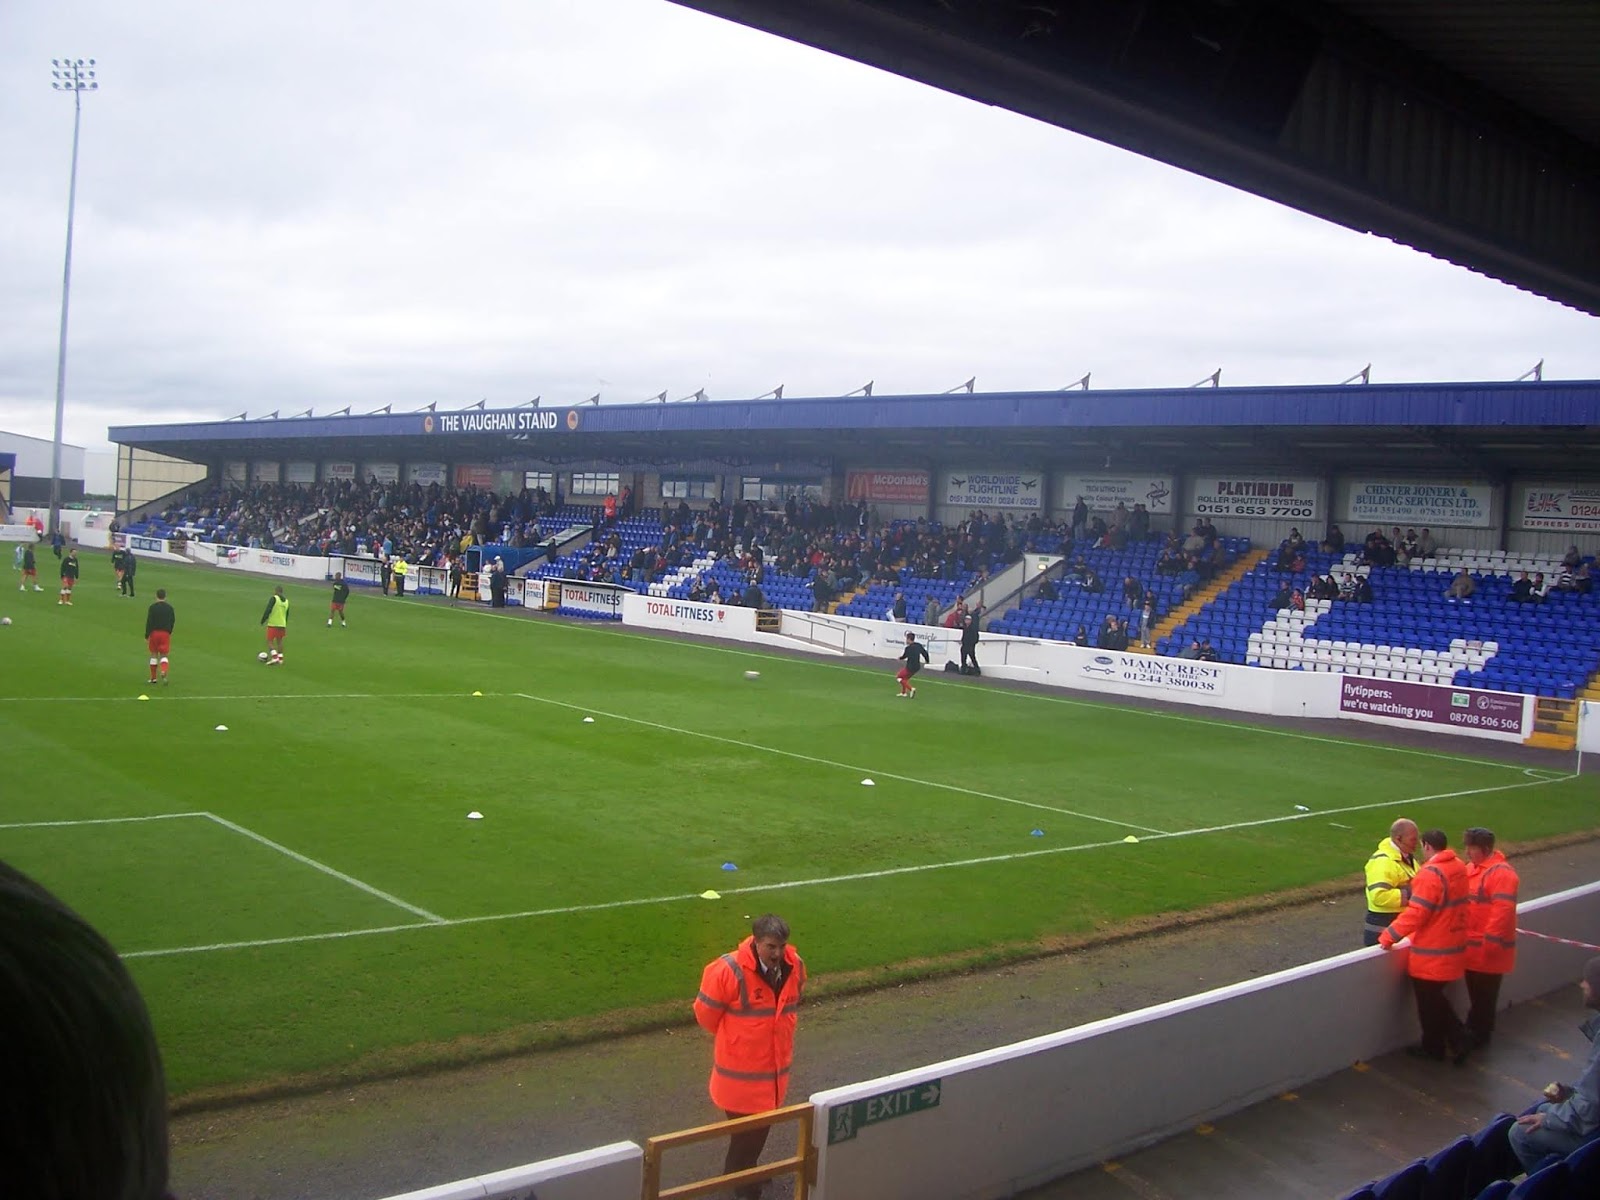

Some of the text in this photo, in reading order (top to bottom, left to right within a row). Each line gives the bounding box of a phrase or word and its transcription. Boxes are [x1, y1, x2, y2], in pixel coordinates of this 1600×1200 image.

[440, 411, 558, 431] THE VAUGHAN STAND
[873, 474, 928, 486] McDonald's
[967, 475, 1021, 485] WORLDWIDE
[968, 484, 1019, 495] FLIGHTLINE
[1217, 481, 1294, 497] PLATINUM
[1365, 485, 1468, 498] CHESTER JOINERY &
[1197, 496, 1314, 507] ROLLER SHUTTER SYSTEMS
[1356, 495, 1404, 505] BUILDING
[1405, 497, 1455, 507] SERVICES
[1197, 504, 1313, 517] 0151 653 7700
[1523, 520, 1570, 528] EXPRESS
[646, 602, 714, 622] TOTALFITNESS
[1120, 657, 1222, 678] MAINCREST
[1138, 668, 1200, 680] VEHICLE HIRE
[1123, 671, 1215, 691] 01244 380038
[1344, 683, 1393, 700] flytippers:
[1343, 698, 1434, 719] we're watching you
[1450, 712, 1519, 730] 08708 506 506
[867, 1089, 915, 1121] EXIT
